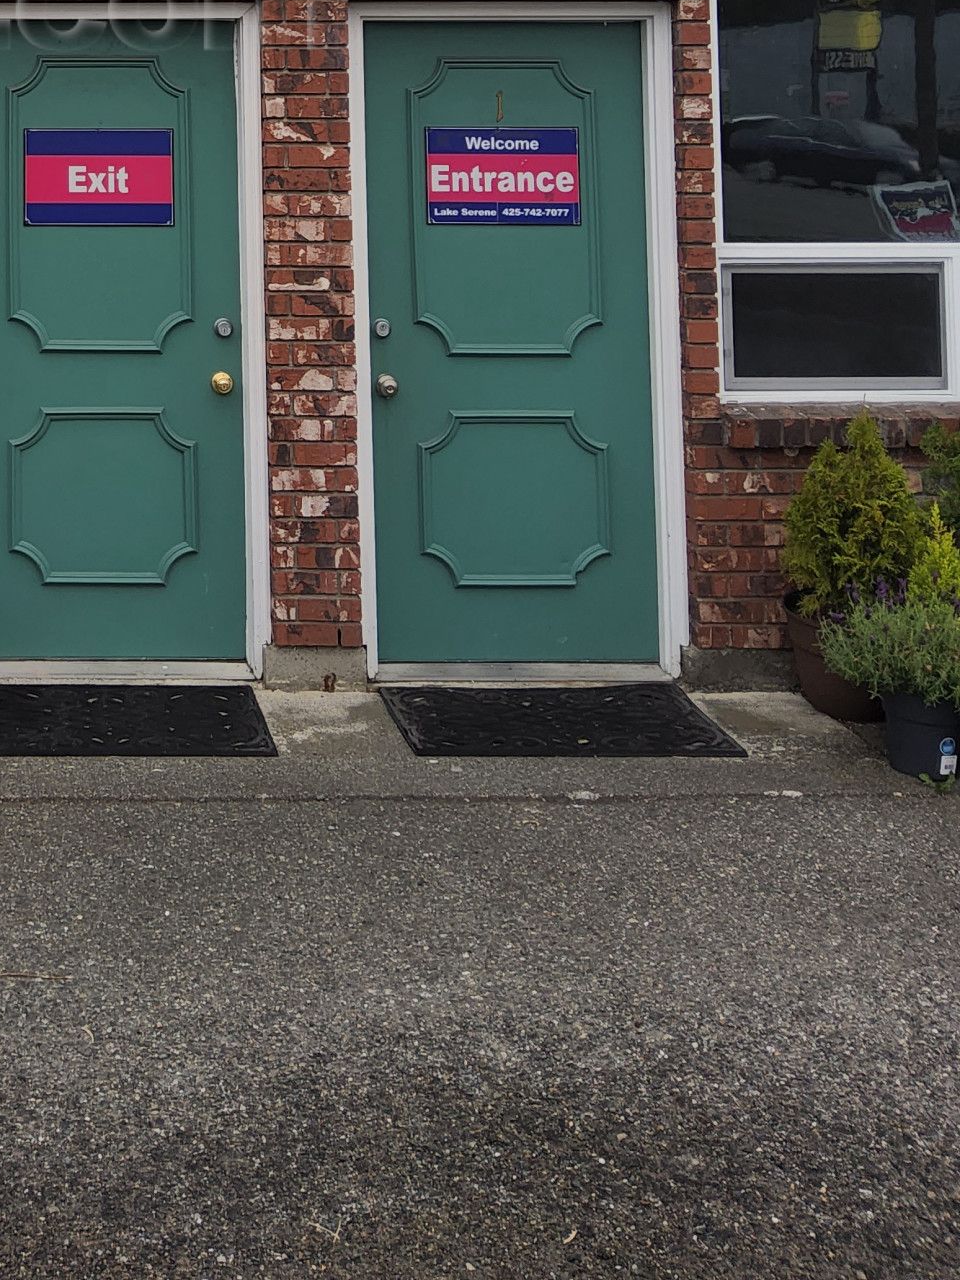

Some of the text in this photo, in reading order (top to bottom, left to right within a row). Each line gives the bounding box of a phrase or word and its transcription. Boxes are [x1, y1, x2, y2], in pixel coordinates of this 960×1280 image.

[465, 136, 540, 151] Welcome
[68, 165, 129, 193] Exit
[430, 164, 575, 193] Entrance
[434, 207, 569, 218] Lake Serene 425-742-7077
